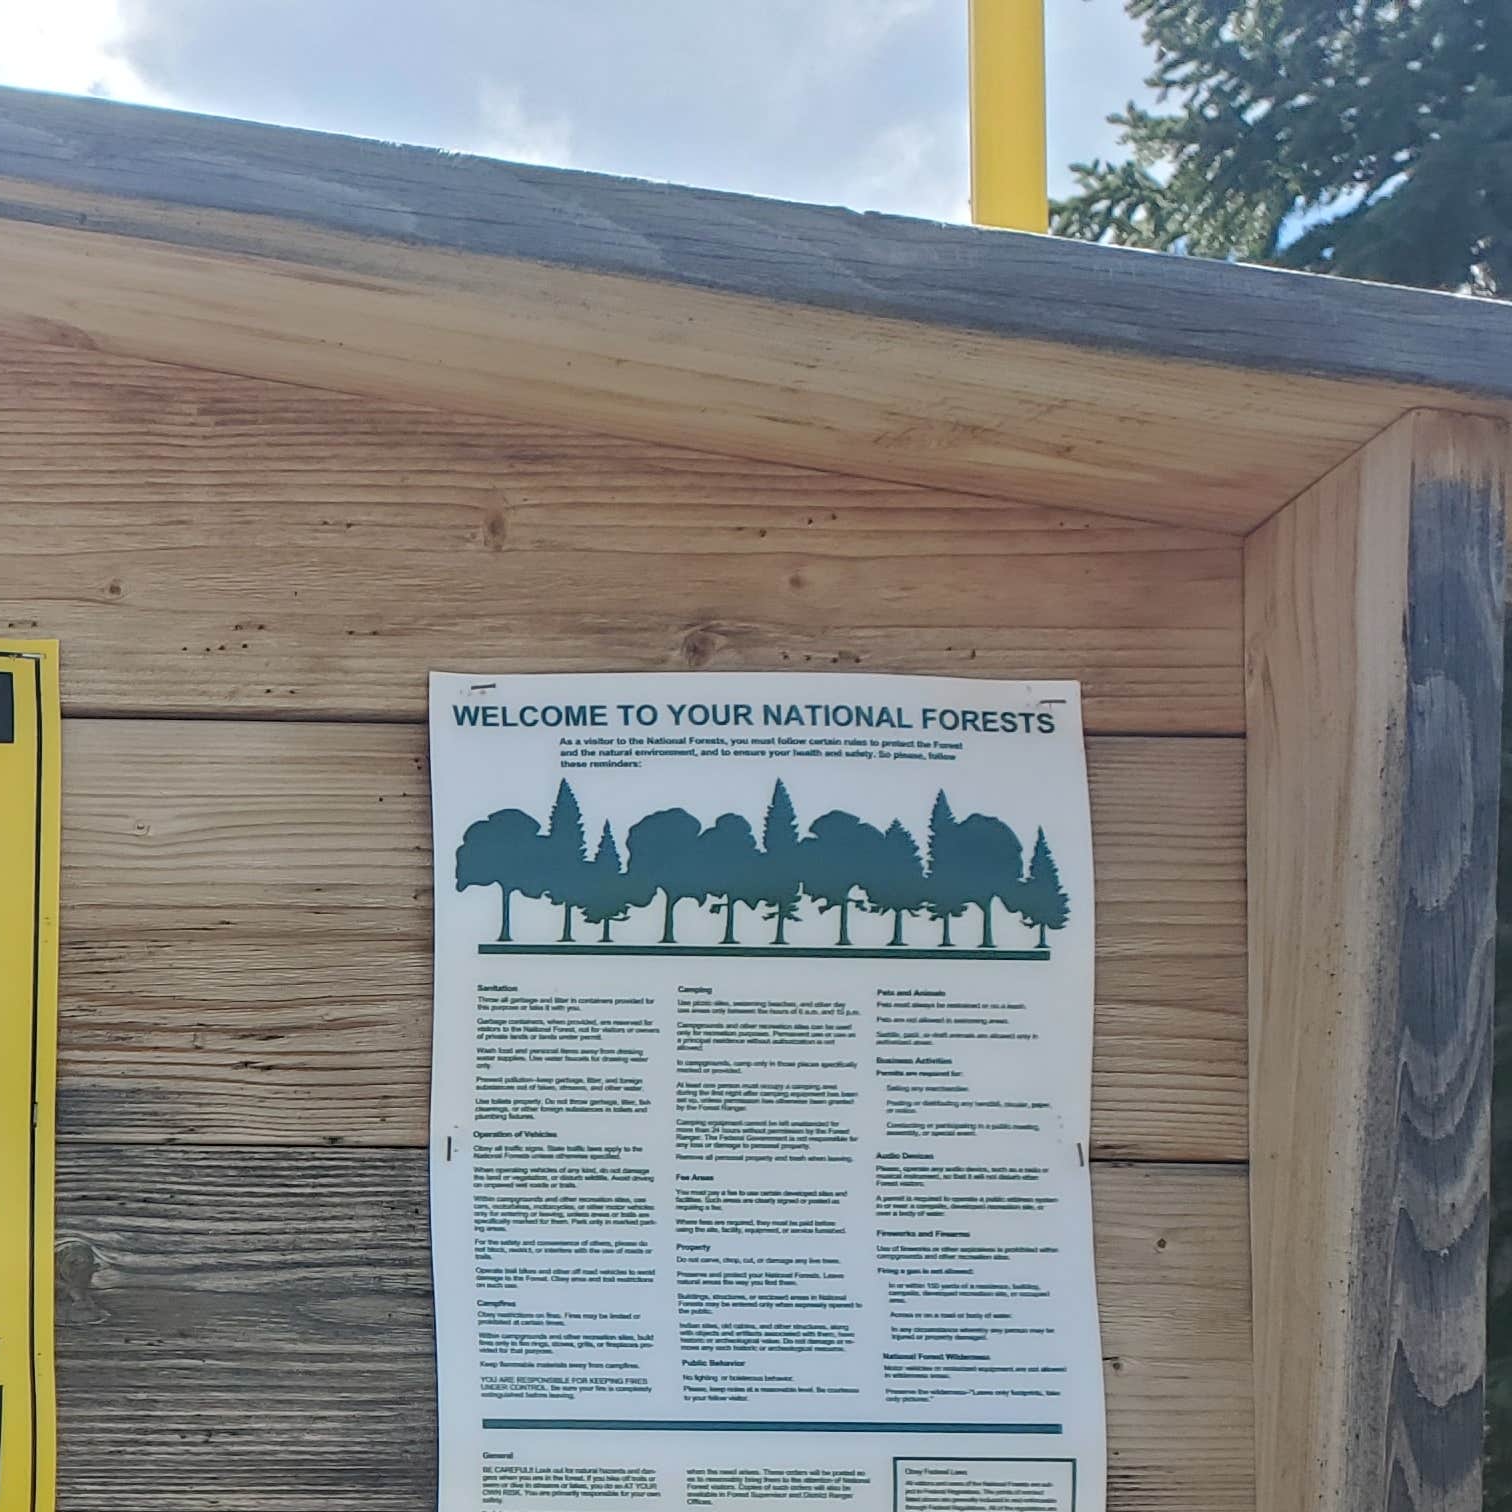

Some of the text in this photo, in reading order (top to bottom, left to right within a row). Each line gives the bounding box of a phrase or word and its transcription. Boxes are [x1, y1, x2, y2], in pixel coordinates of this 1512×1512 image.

[452, 703, 1055, 734] WELCOME TO YOUR NATIONAL FORESTS
